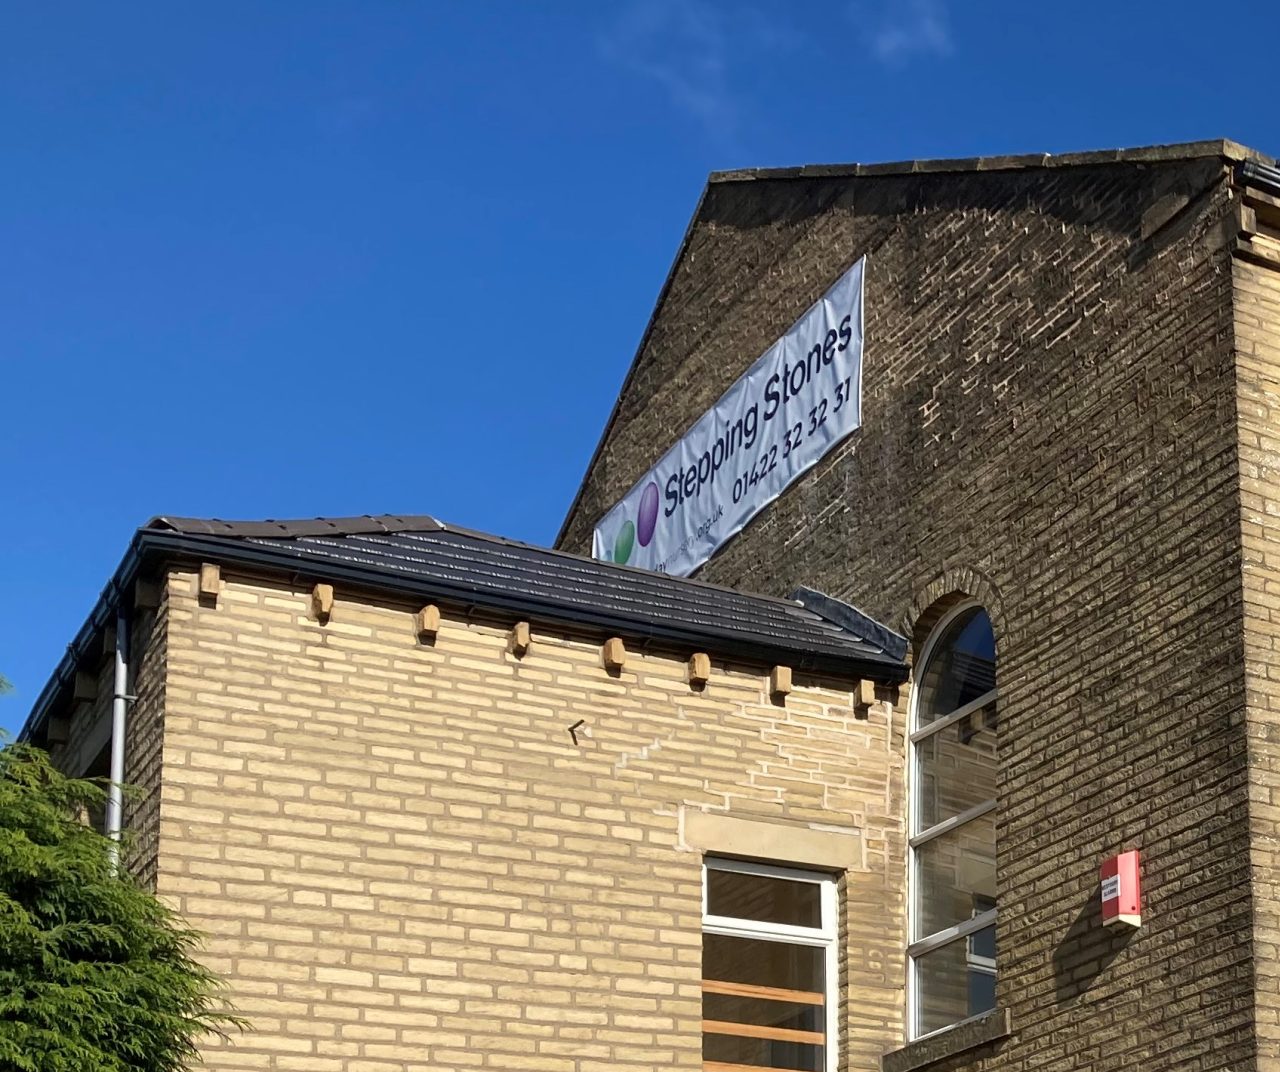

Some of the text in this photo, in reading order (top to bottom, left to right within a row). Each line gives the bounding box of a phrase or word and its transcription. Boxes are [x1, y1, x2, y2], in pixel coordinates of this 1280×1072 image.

[664, 314, 852, 518] Stepping Stones
[732, 376, 851, 505] 01422 32 32 31
